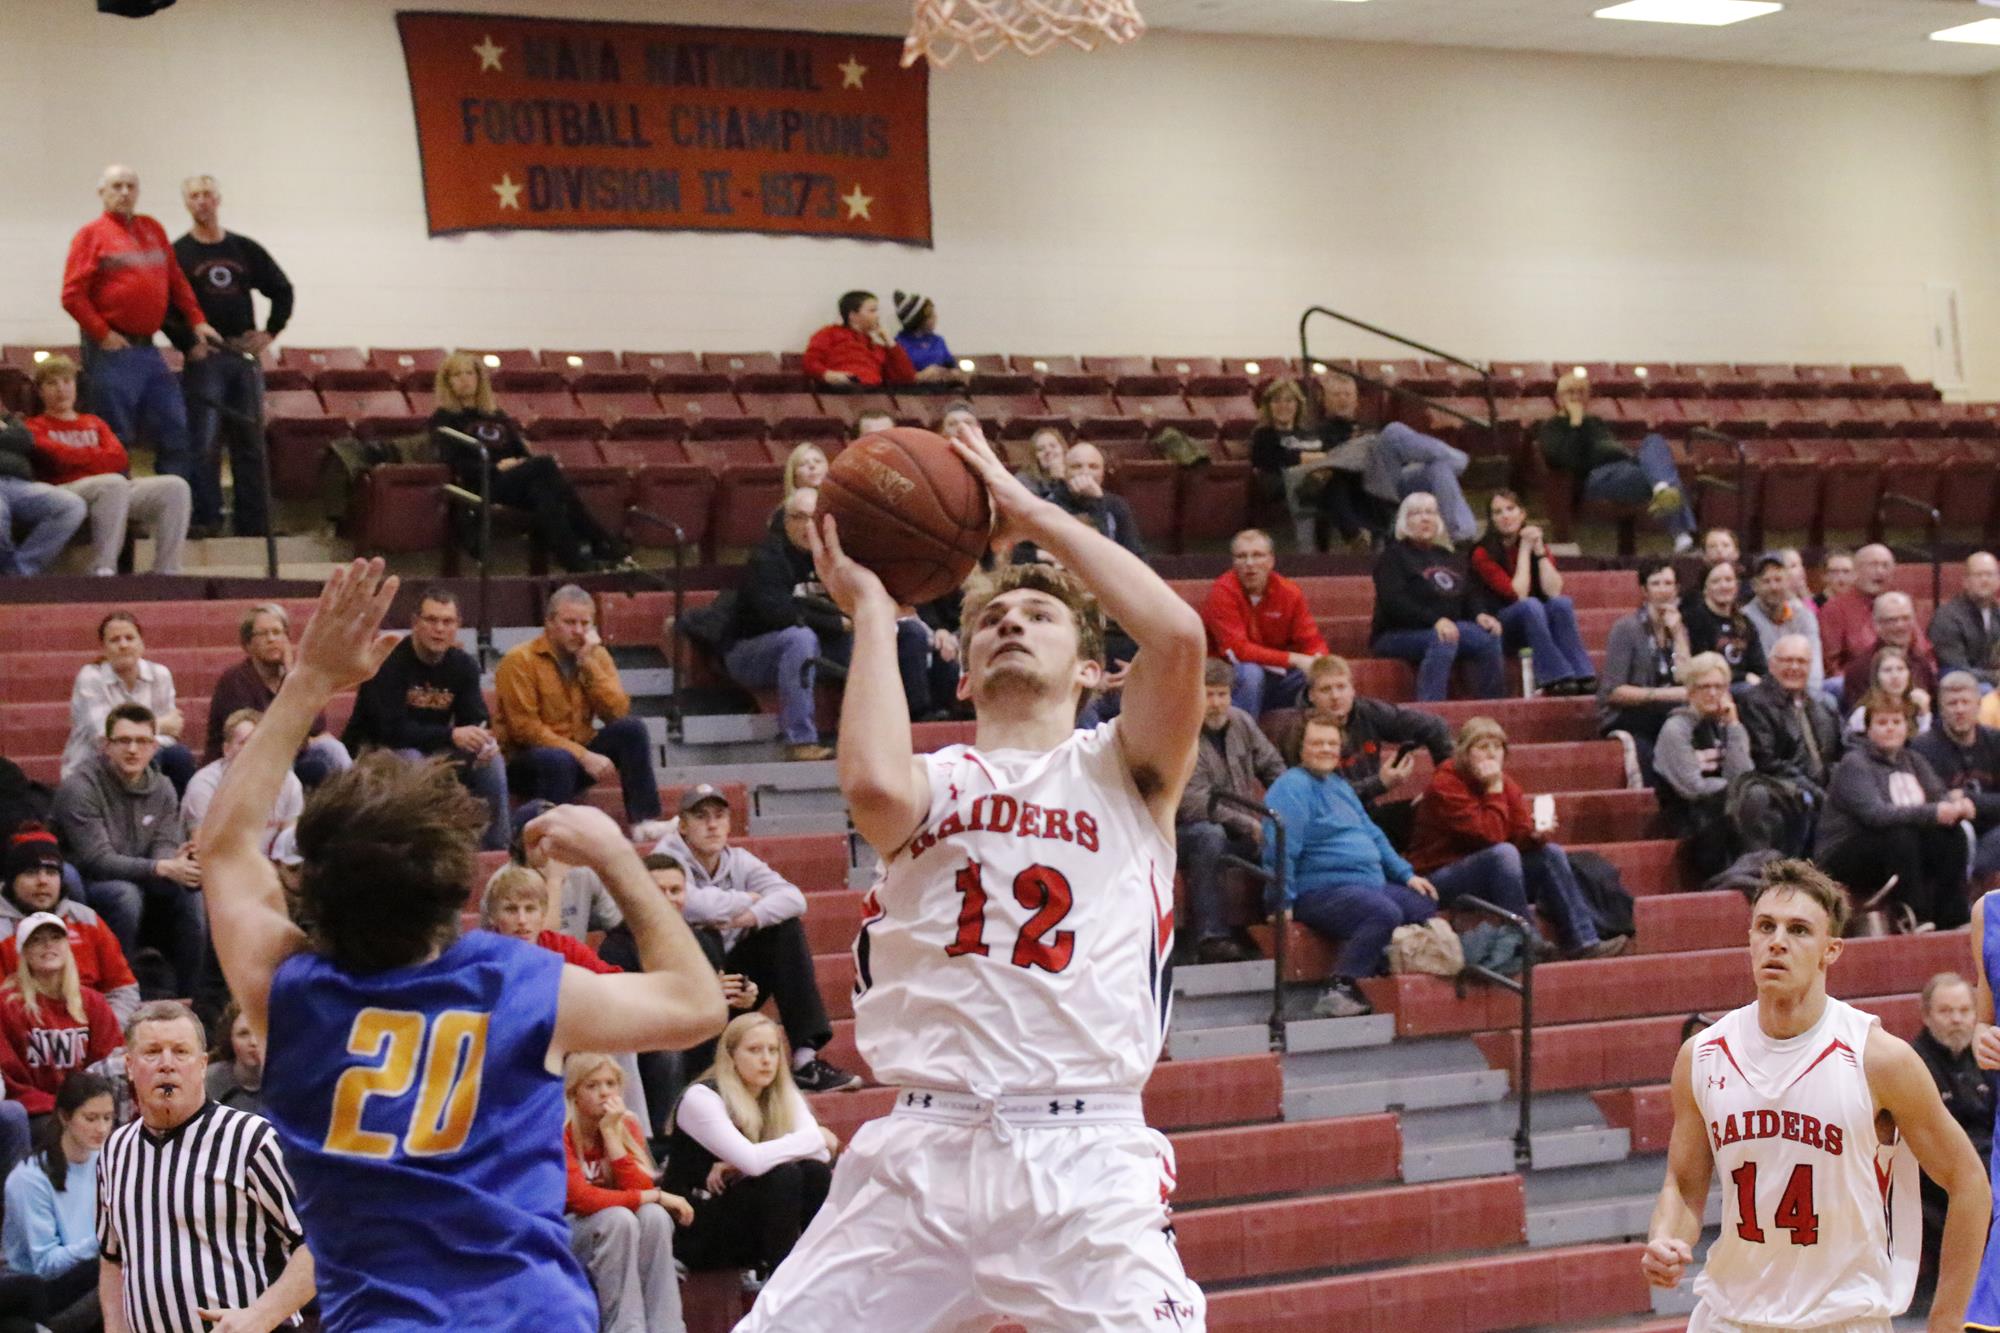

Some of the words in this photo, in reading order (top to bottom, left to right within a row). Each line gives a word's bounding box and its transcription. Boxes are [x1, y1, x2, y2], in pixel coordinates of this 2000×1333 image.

[643, 41, 823, 92] NATIONAL
[461, 97, 653, 148] FOOTBALL
[669, 105, 891, 160] CHAMPIONS
[527, 163, 682, 214] DIVISION
[944, 856, 1076, 974] 12
[322, 1006, 493, 1161] 20
[1711, 1109, 1844, 1157] RAIDERS
[1730, 1160, 1820, 1247] 14
